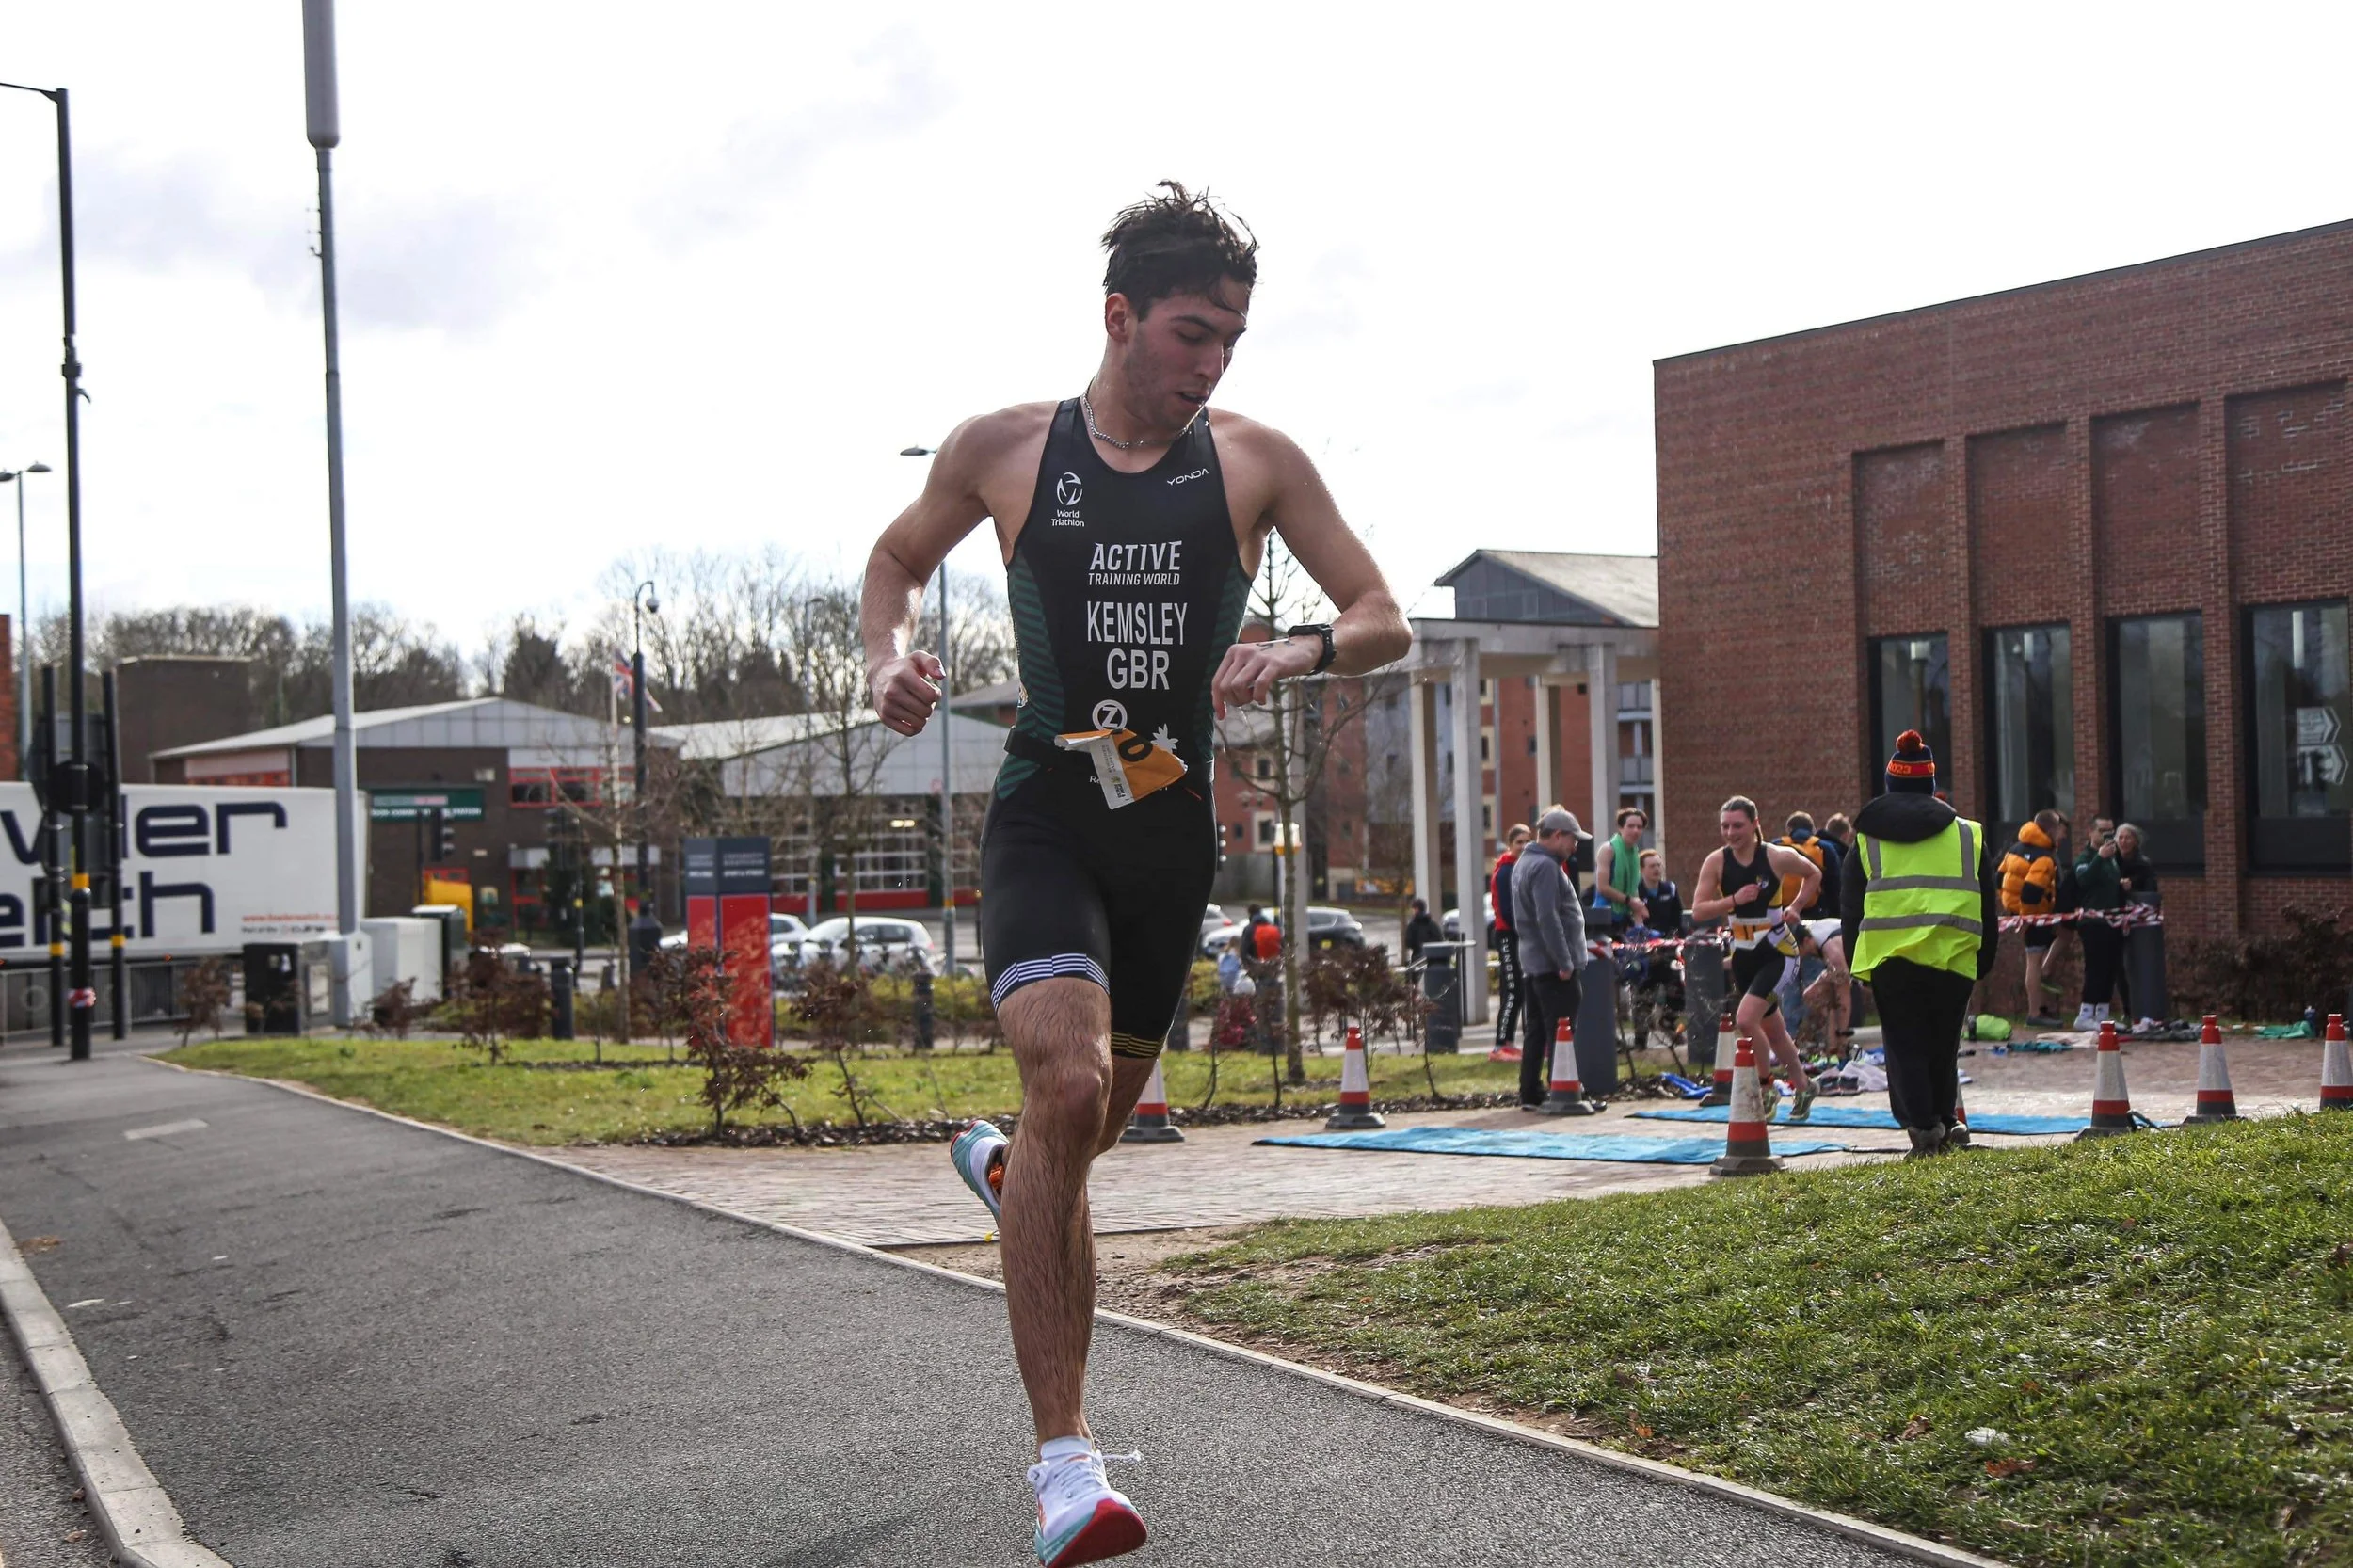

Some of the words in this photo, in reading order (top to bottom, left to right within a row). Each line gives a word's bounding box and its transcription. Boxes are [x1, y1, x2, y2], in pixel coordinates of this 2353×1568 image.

[1166, 468, 1209, 486] YONDA
[1050, 518, 1085, 527] Triathlon
[1056, 509, 1080, 518] World
[1089, 540, 1183, 571] ACTIVE
[1088, 572, 1141, 585] TRAINING
[1144, 572, 1180, 585] WORLD
[1086, 600, 1188, 645] KEMSLEY
[1106, 648, 1170, 690] GBR
